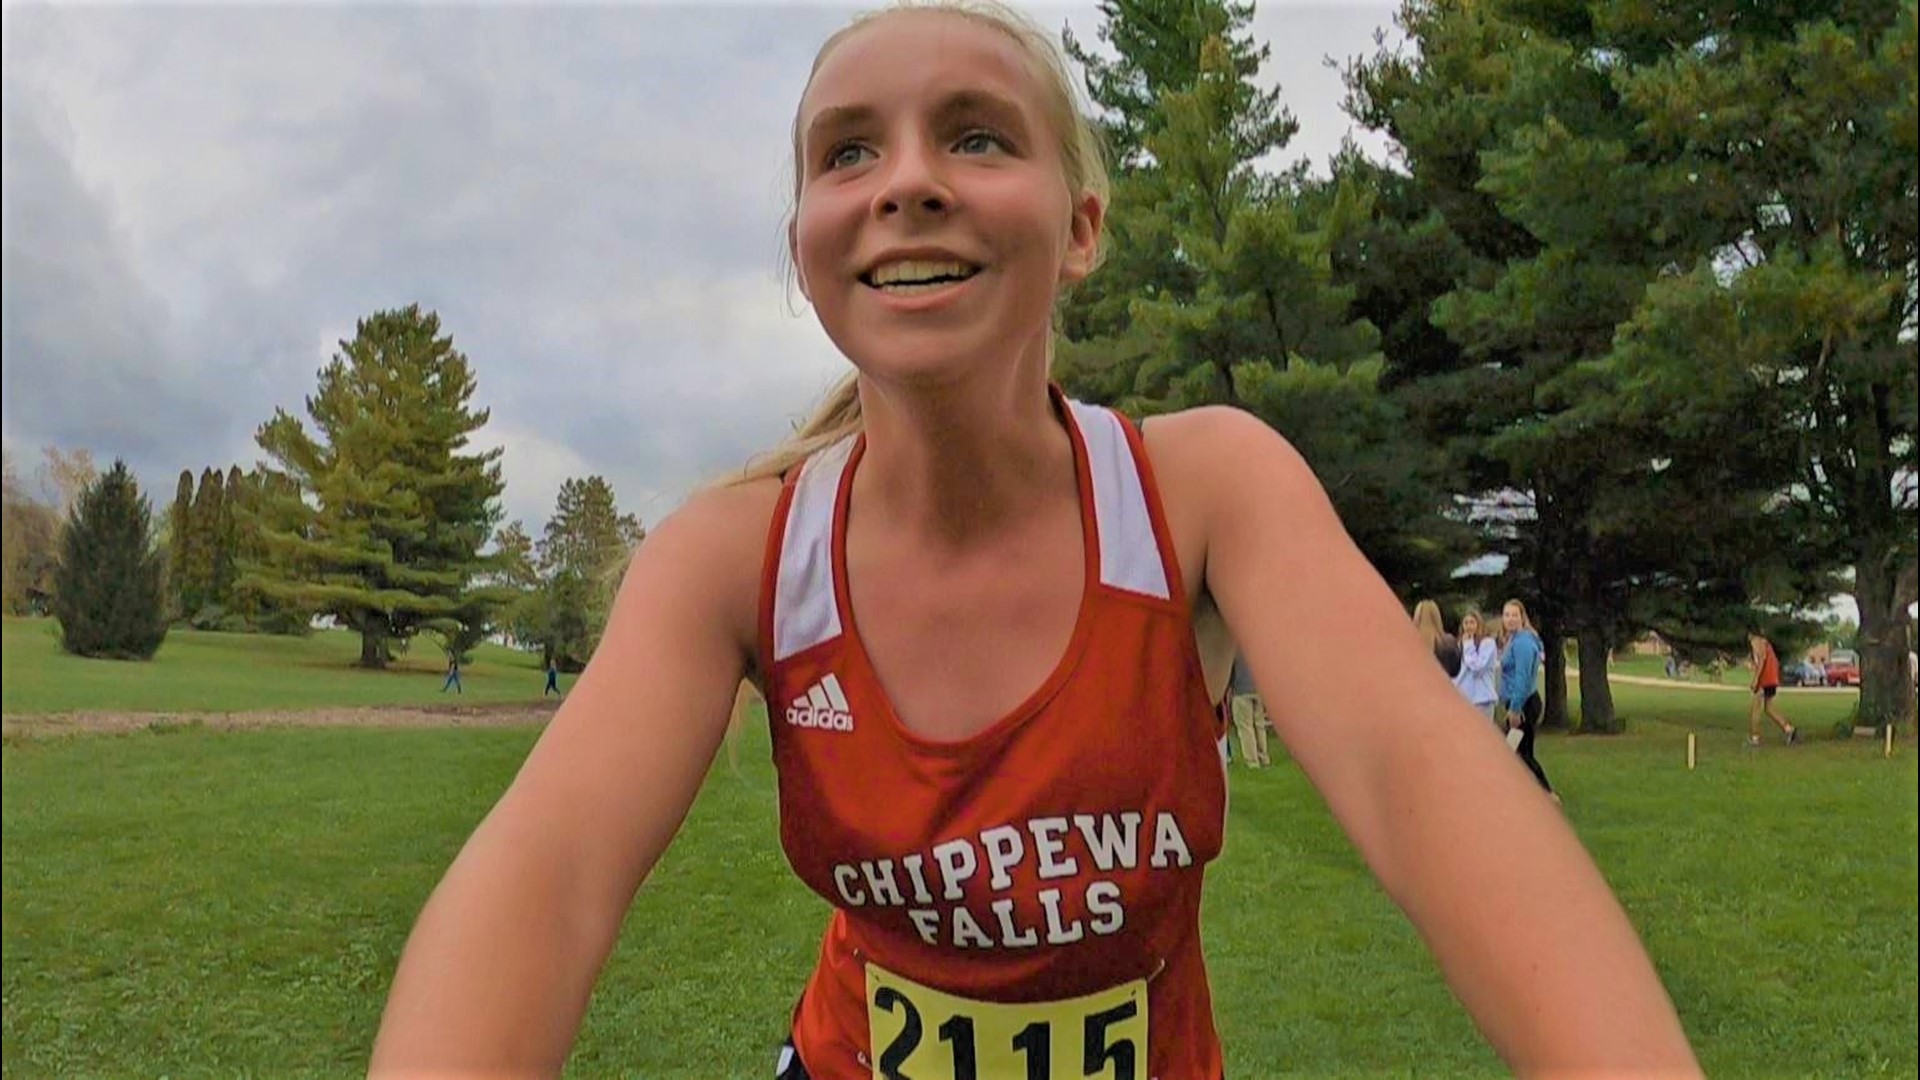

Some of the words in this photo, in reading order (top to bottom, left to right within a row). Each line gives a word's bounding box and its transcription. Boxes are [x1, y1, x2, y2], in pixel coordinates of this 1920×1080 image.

[786, 704, 854, 733] adidas
[833, 811, 1193, 907] CHIPPEWA
[909, 881, 1125, 949] FALLS
[873, 985, 1138, 1080] 2115
